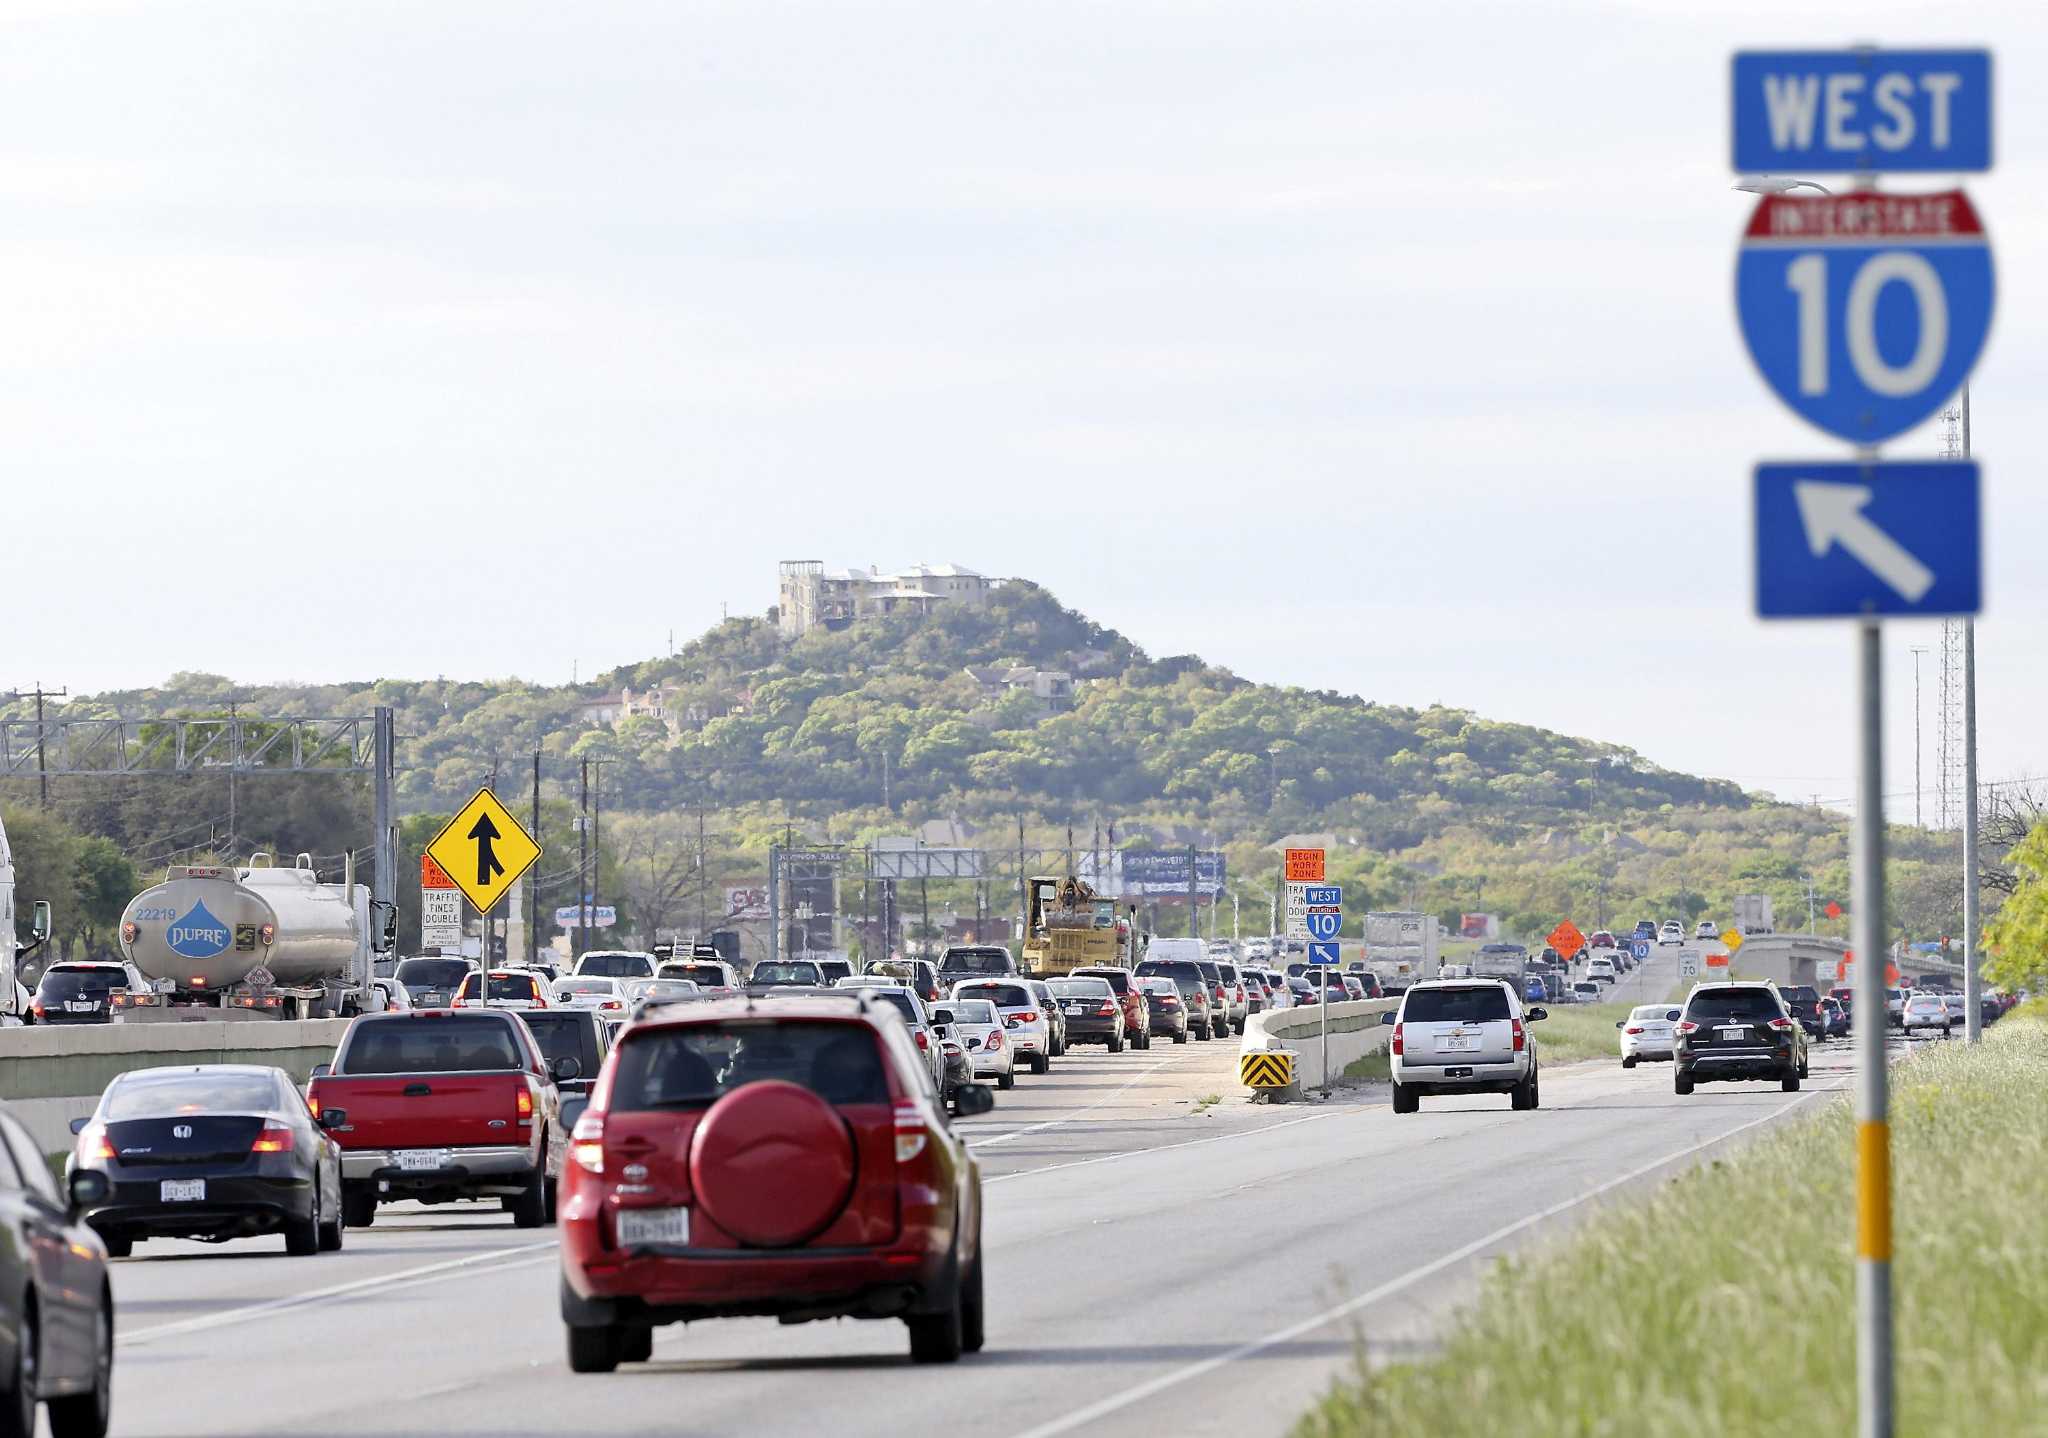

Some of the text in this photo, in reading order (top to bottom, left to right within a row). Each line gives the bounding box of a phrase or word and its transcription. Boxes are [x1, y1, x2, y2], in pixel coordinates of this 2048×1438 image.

[1763, 72, 1963, 151] WEST
[1785, 250, 1950, 398] 10
[1292, 852, 1318, 861] BEGIN
[1293, 861, 1317, 869] WORK
[1293, 869, 1317, 878] ZONE
[425, 893, 459, 902] TRAFFIC
[1310, 890, 1337, 901] WEST
[1293, 896, 1306, 905] FIN
[430, 904, 454, 913] FINES
[1289, 907, 1308, 915] DOU
[135, 908, 176, 921] 22219
[426, 914, 459, 923] DOUBLE
[1313, 914, 1336, 934] 10
[1634, 945, 1647, 957] 10
[1683, 966, 1696, 975] 70
